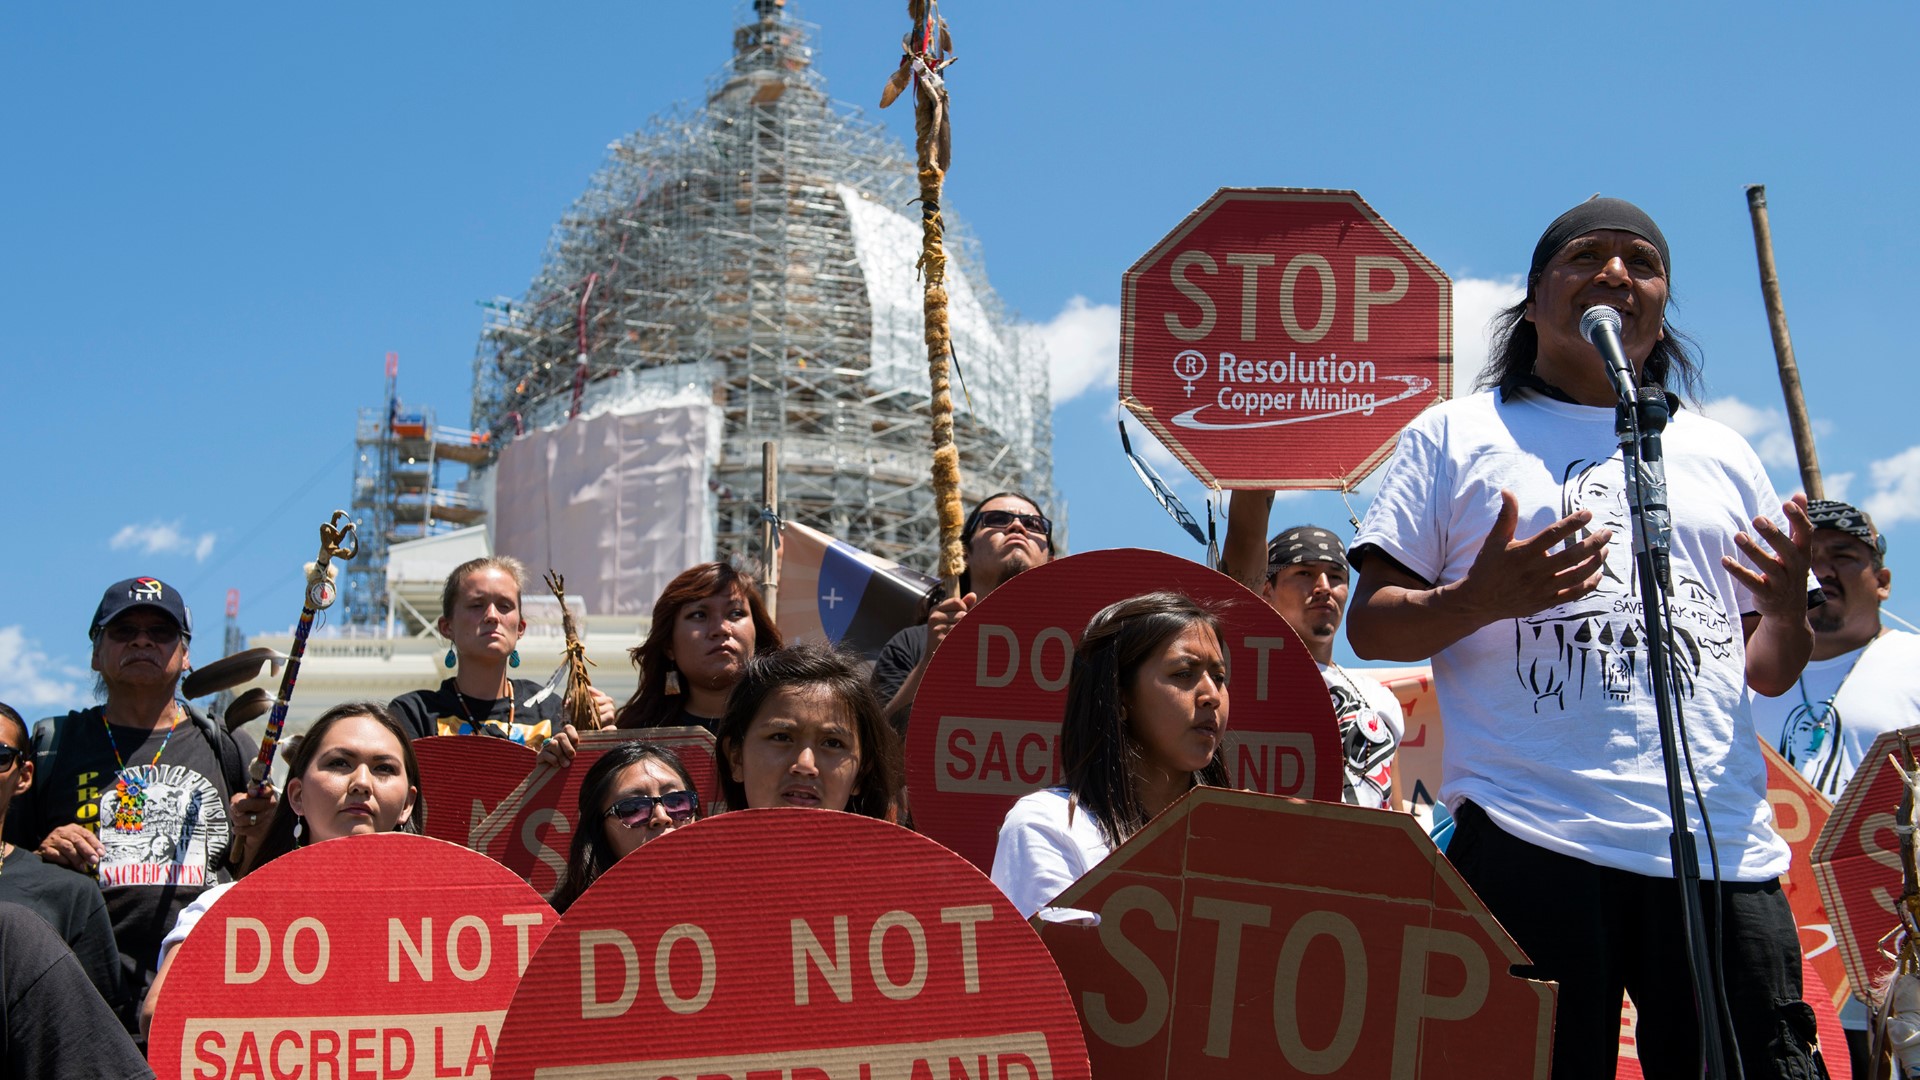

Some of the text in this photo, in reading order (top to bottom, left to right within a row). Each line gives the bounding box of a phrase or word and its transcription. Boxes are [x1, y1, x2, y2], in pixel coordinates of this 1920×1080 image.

[1164, 250, 1410, 343] STOP
[1218, 352, 1376, 384] Resolution
[1217, 387, 1376, 416] Copper Mining
[1613, 600, 1645, 615] SAVE
[1697, 611, 1726, 633] FLAT
[976, 624, 1075, 692] DO
[104, 863, 204, 887] SACRED SITES
[223, 913, 543, 985] DO NOT
[579, 904, 994, 1020] DO NOT
[1082, 885, 1491, 1080] STOP
[193, 1027, 415, 1080] SACRED
